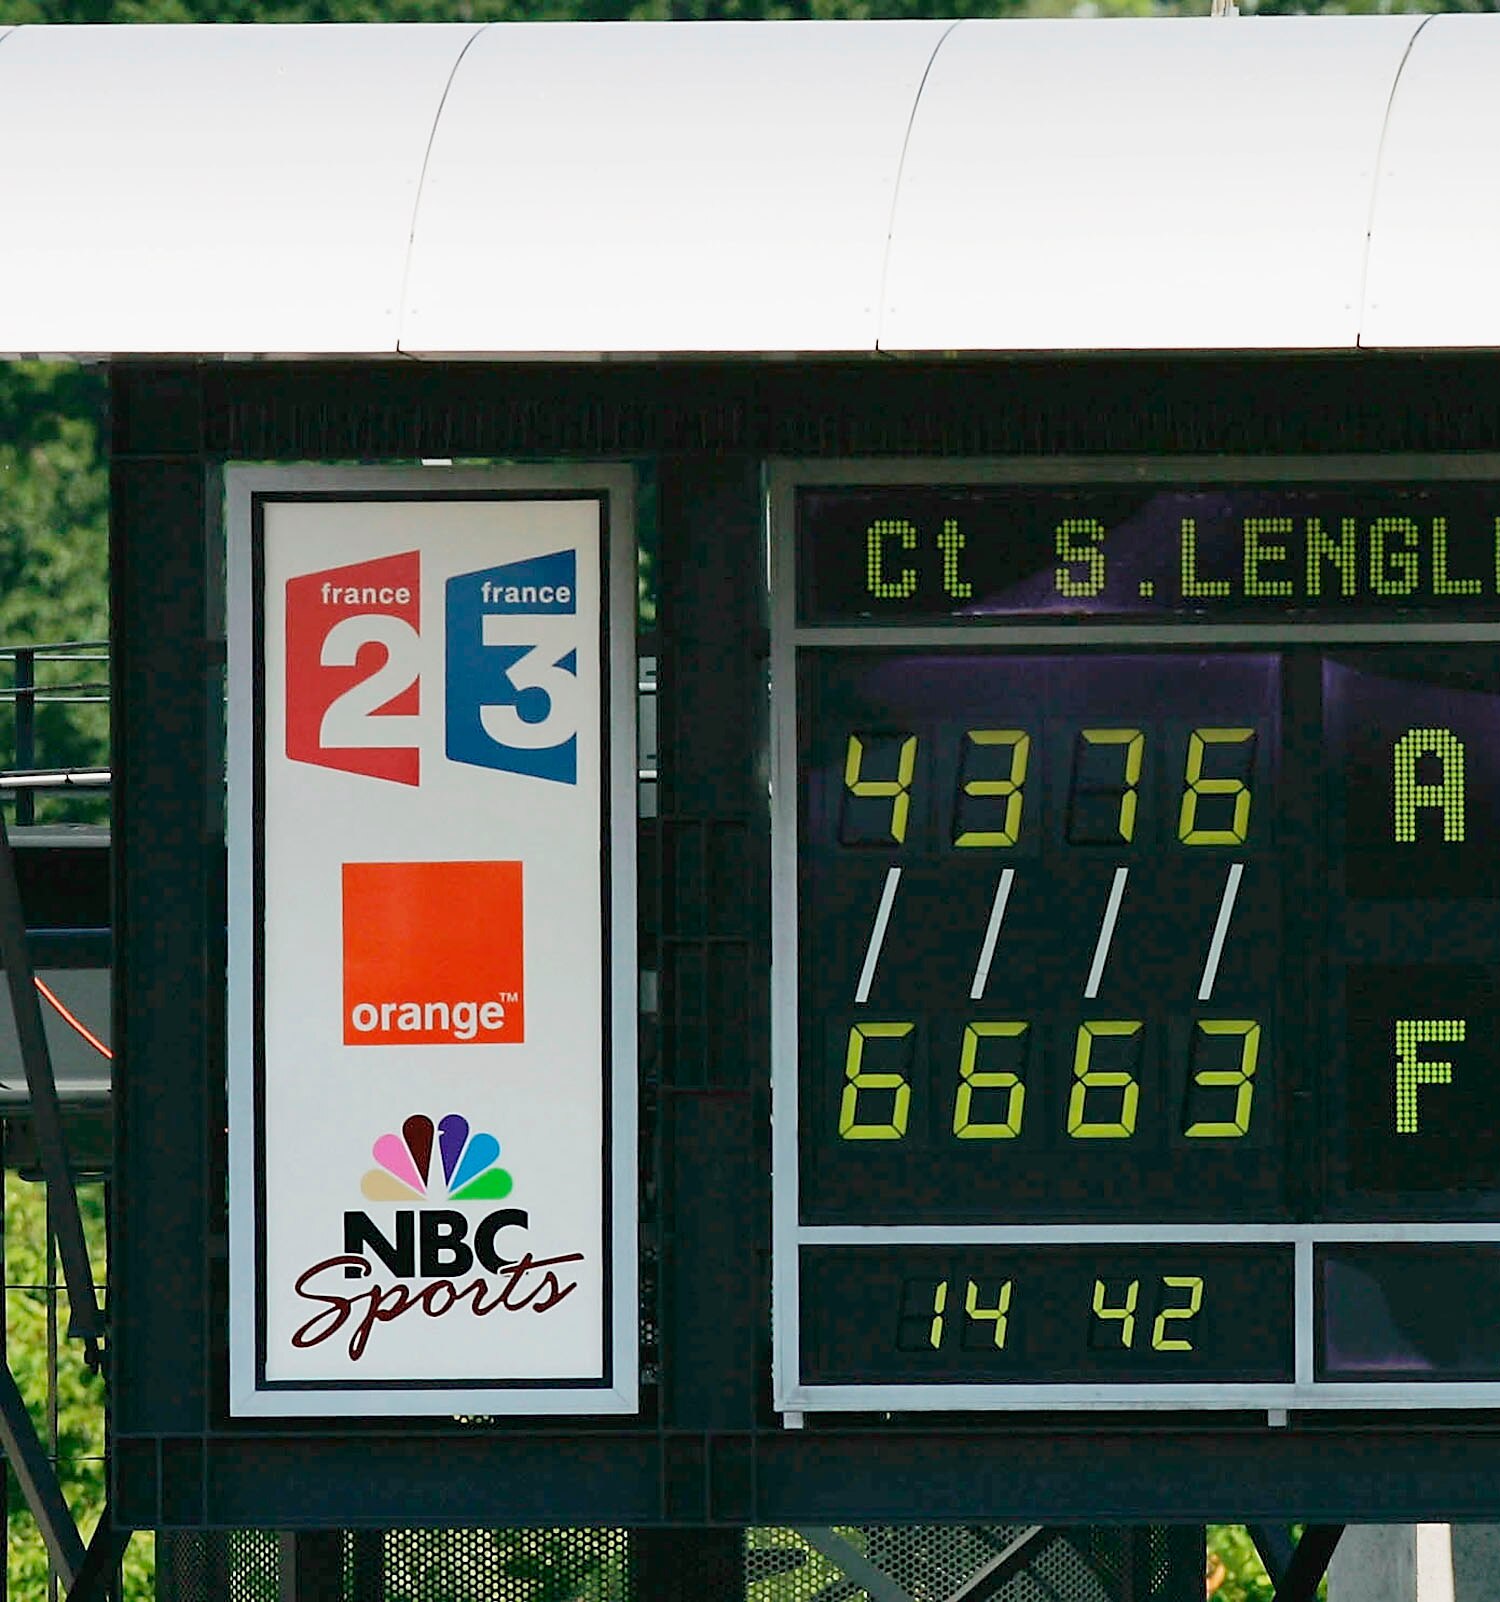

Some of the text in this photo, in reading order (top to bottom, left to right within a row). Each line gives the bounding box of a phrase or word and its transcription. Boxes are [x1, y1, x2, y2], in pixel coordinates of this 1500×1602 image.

[321, 581, 411, 605] france
[481, 581, 572, 605] france
[868, 519, 973, 598] Ct
[320, 614, 420, 749] 2
[480, 615, 576, 750] 3
[353, 1000, 505, 1040] orange
[344, 1209, 529, 1279] NBC
[292, 1253, 584, 1361] Sports
[929, 1277, 1204, 1352] 14 42
